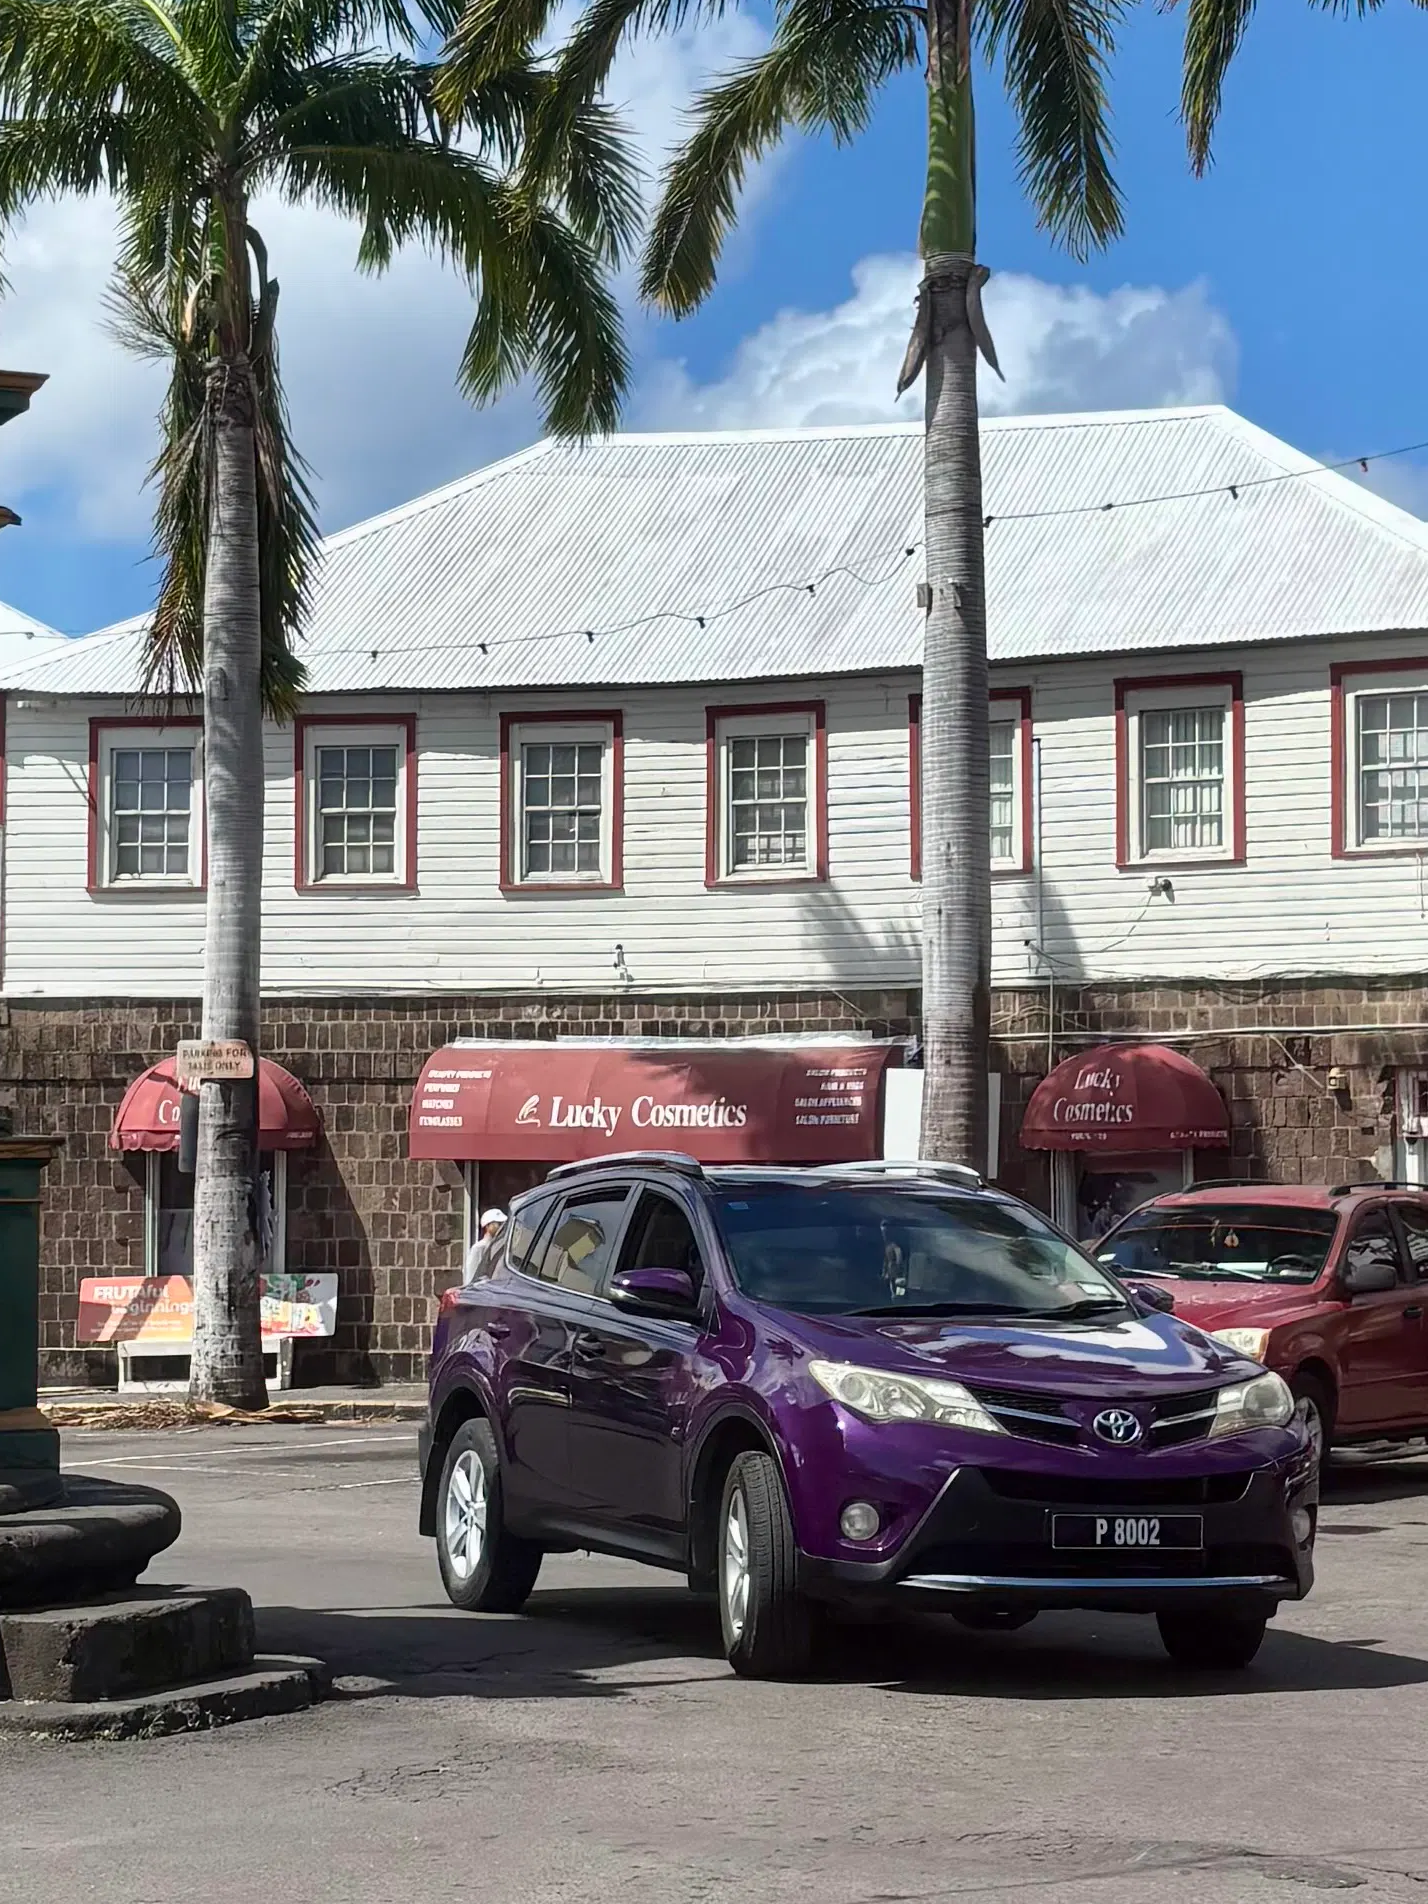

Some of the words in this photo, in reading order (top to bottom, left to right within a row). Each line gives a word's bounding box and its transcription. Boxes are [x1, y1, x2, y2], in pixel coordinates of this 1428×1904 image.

[226, 1048, 247, 1057] FOR
[215, 1061, 242, 1071] ONLY
[1074, 1067, 1122, 1096] Lucky
[159, 1099, 180, 1124] Co
[548, 1096, 622, 1137] Lucky
[631, 1095, 748, 1128] Cosmetics
[1053, 1097, 1133, 1123] Cosmetics
[1096, 1518, 1108, 1545] P
[1114, 1518, 1160, 1546] 8002
